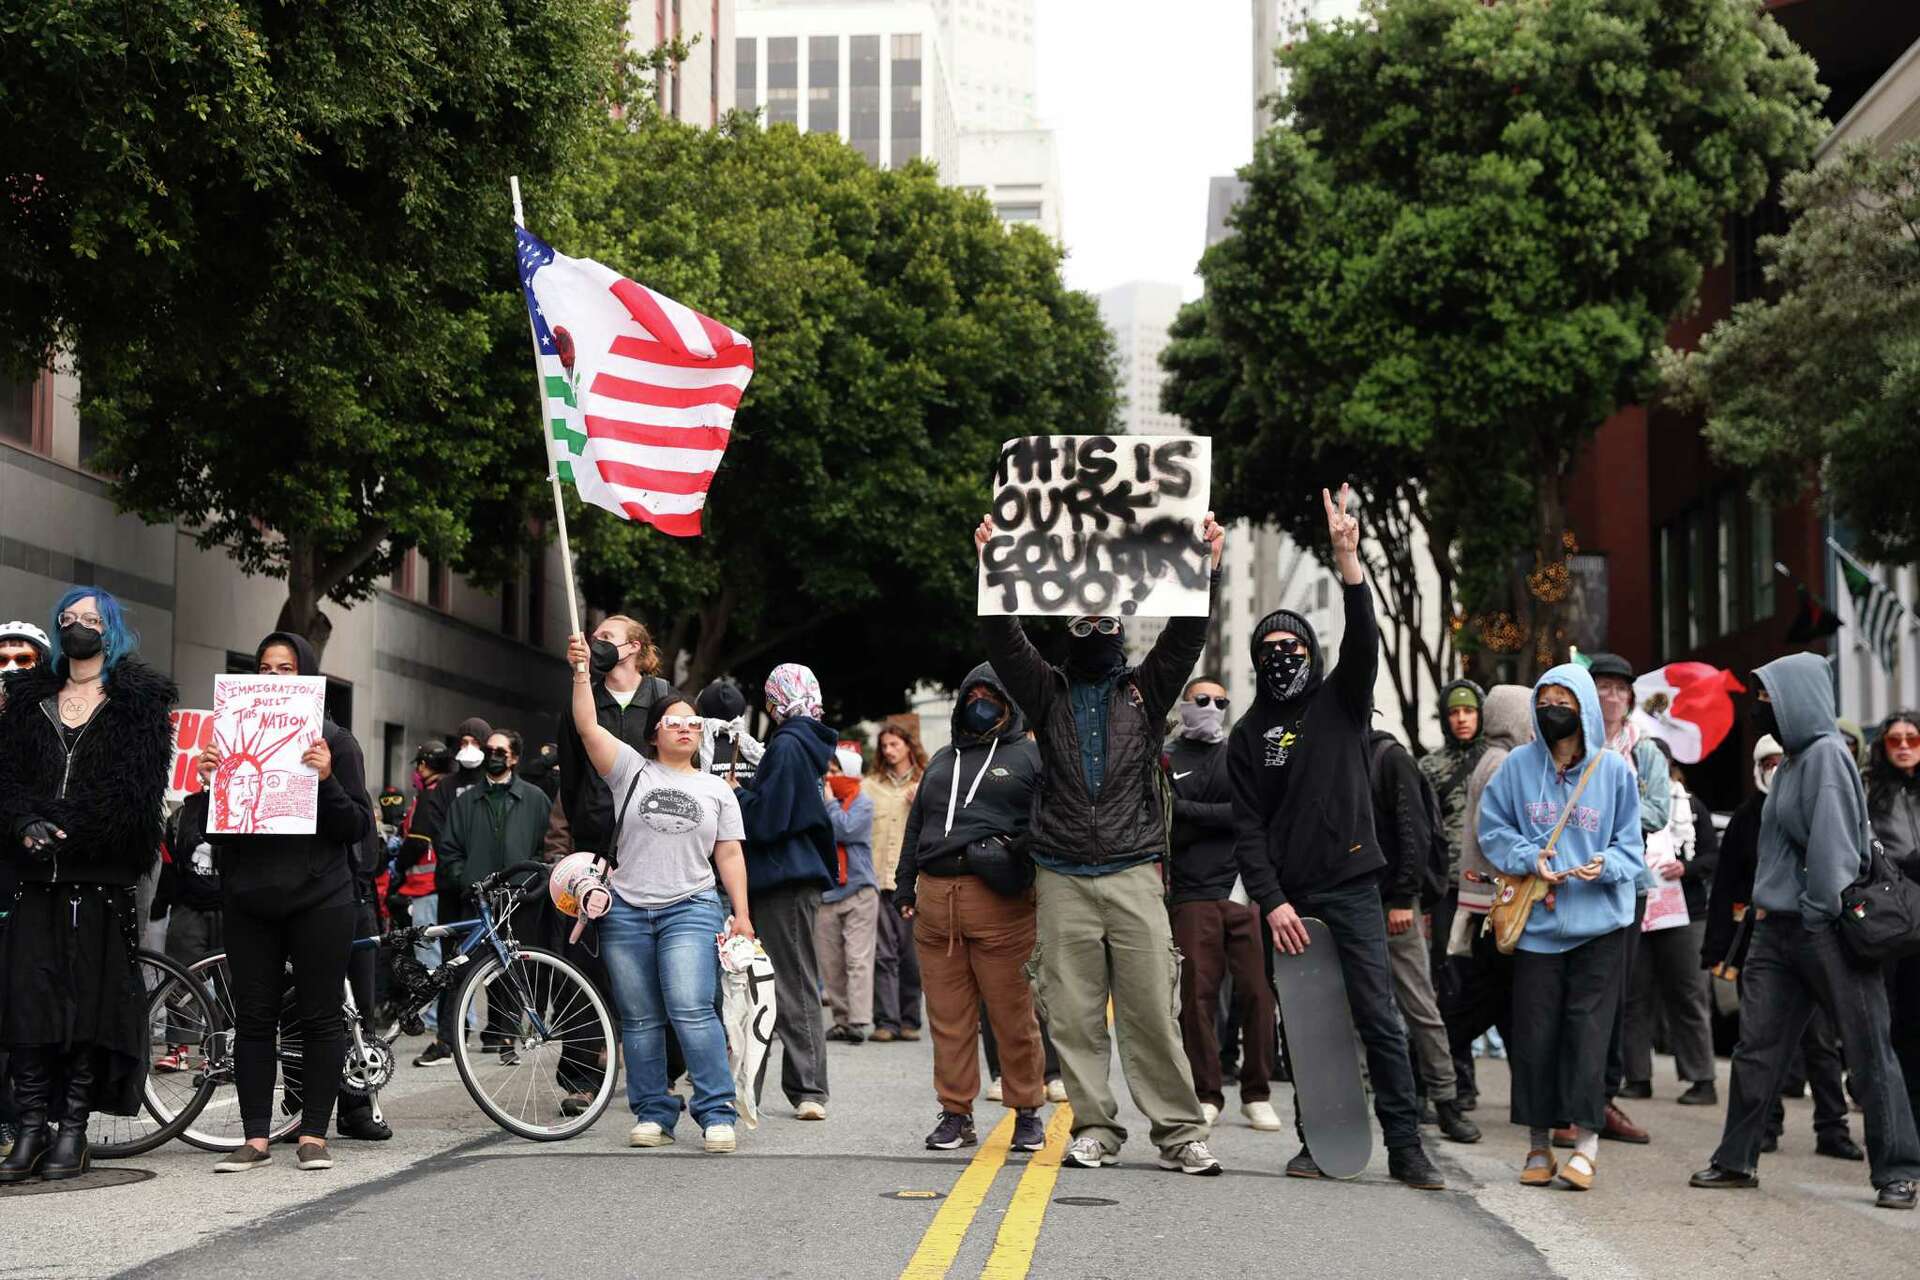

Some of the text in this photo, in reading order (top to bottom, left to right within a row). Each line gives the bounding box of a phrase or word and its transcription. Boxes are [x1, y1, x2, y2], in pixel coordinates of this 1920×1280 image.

[998, 437, 1200, 499] THIS IS
[227, 683, 316, 699] IMMIGRATION
[251, 696, 291, 708] BUILT
[232, 707, 309, 729] THIS NATION
